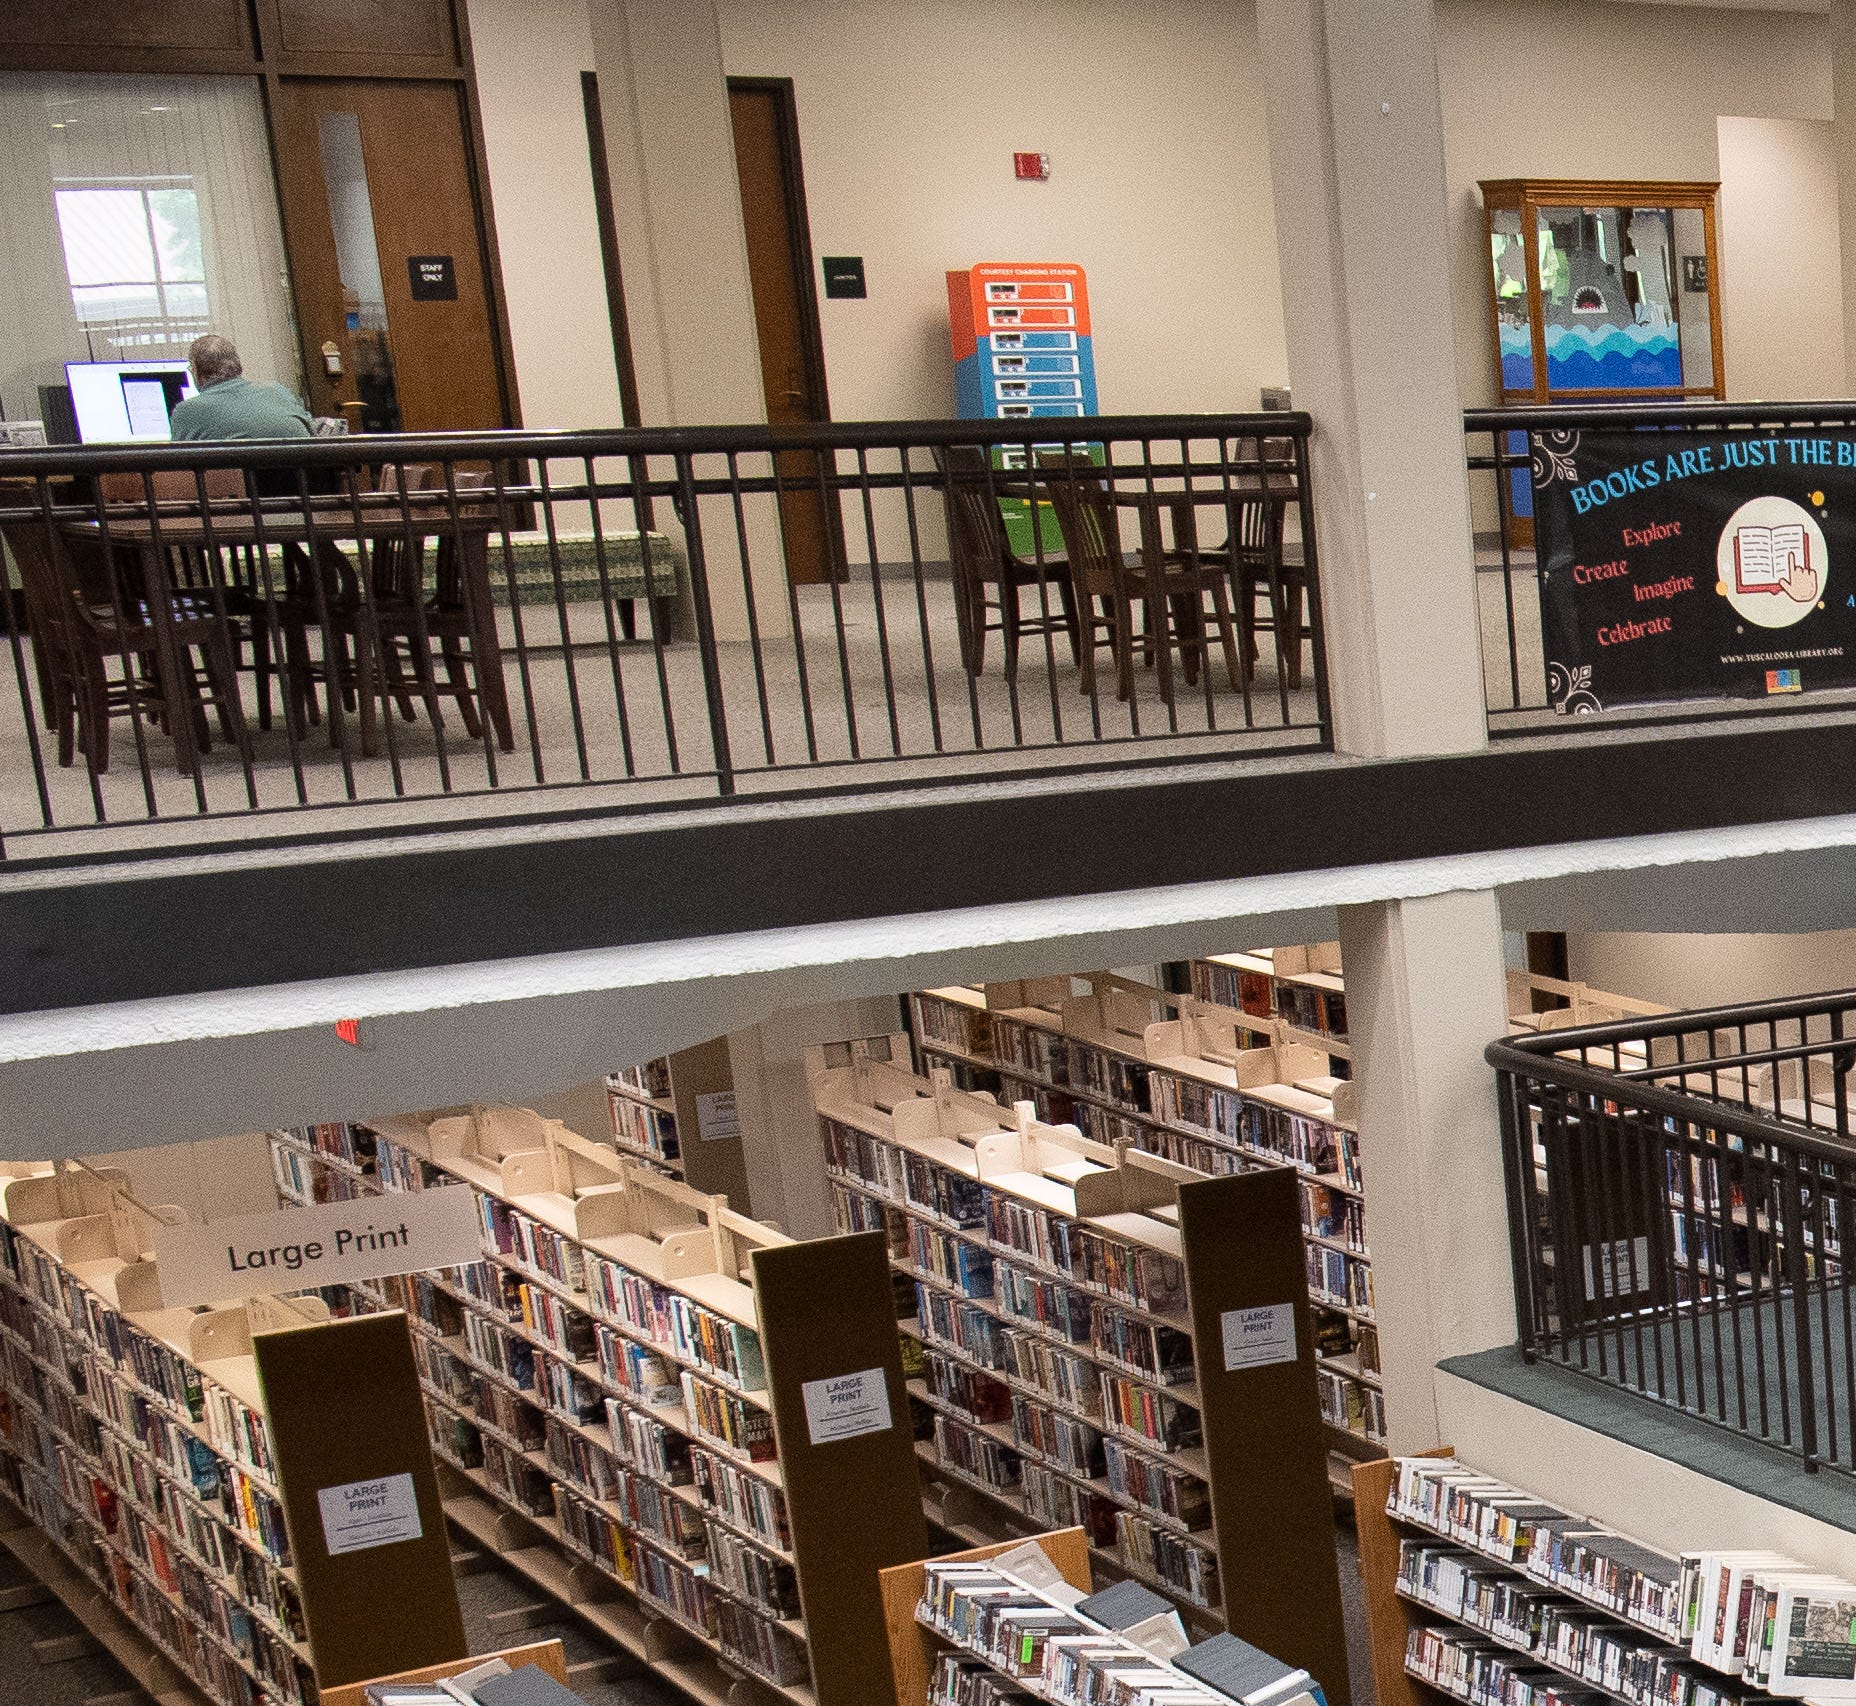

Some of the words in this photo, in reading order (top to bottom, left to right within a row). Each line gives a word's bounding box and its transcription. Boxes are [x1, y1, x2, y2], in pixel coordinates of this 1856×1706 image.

[1570, 462, 1662, 515] BOOKS
[1664, 446, 1715, 482] ARE
[1717, 440, 1778, 471] JUST
[1783, 438, 1833, 465] THE
[1622, 520, 1682, 548] Explore
[1573, 558, 1629, 586] Create
[1633, 574, 1695, 602] Imagine
[1597, 615, 1673, 647] Celebrate
[228, 1242, 322, 1272] Large
[335, 1225, 409, 1256] Print
[1240, 1310, 1274, 1324] LARGE
[1243, 1321, 1273, 1335] PRINT
[826, 1377, 863, 1394] LARGE
[830, 1388, 862, 1405] PRINT
[344, 1482, 389, 1502] LARGE
[349, 1496, 388, 1512] PRINT
